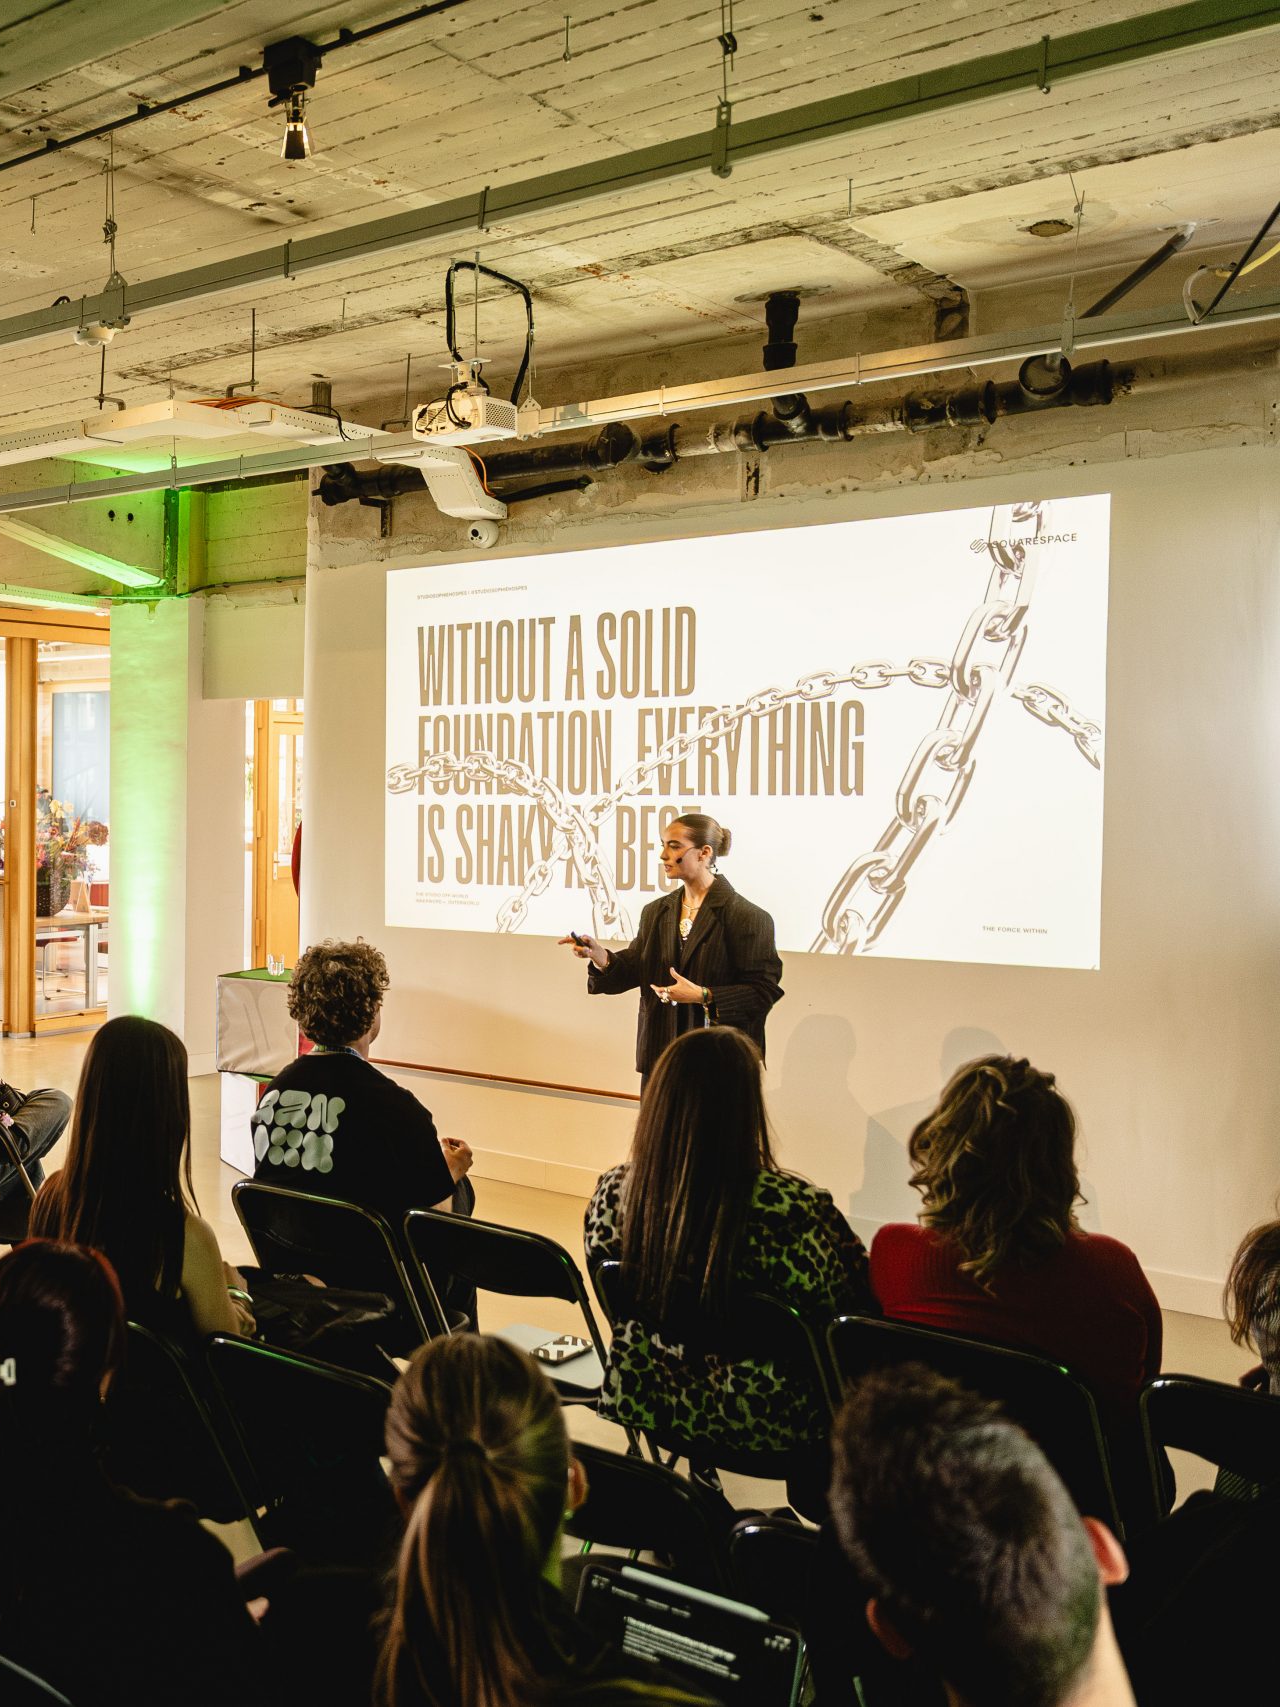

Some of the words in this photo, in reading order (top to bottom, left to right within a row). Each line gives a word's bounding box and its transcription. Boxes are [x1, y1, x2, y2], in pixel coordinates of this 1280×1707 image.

[992, 533, 1077, 549] SQUARESPACE
[417, 616, 556, 707] WITHOUT
[565, 614, 585, 701] A
[596, 606, 696, 701] SOLID
[637, 700, 865, 797] EVERYTHING
[417, 804, 444, 883] IS
[1022, 927, 1048, 935] WITHIN
